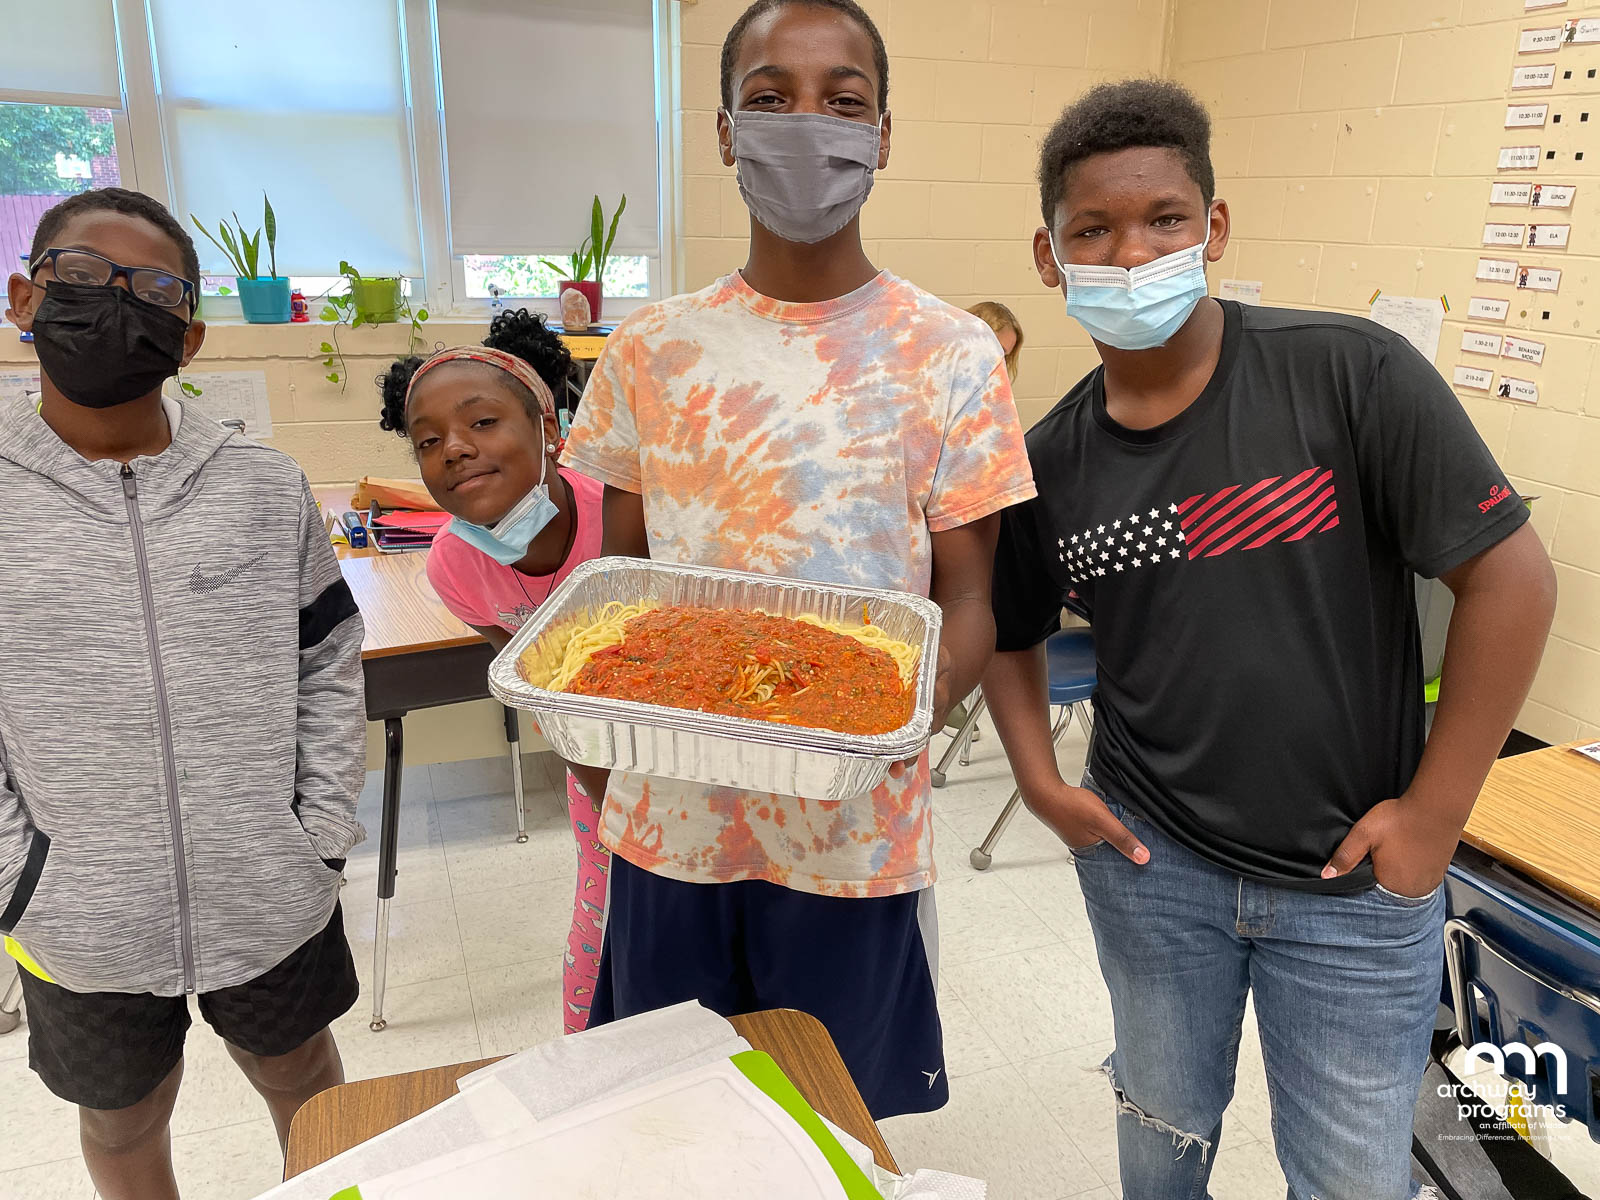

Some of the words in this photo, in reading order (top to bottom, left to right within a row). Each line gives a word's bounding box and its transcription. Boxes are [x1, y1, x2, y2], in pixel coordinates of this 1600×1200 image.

[1518, 346, 1541, 356] BEHAVIOR
[1521, 353, 1534, 361] MOD
[1515, 386, 1528, 395] PACK
